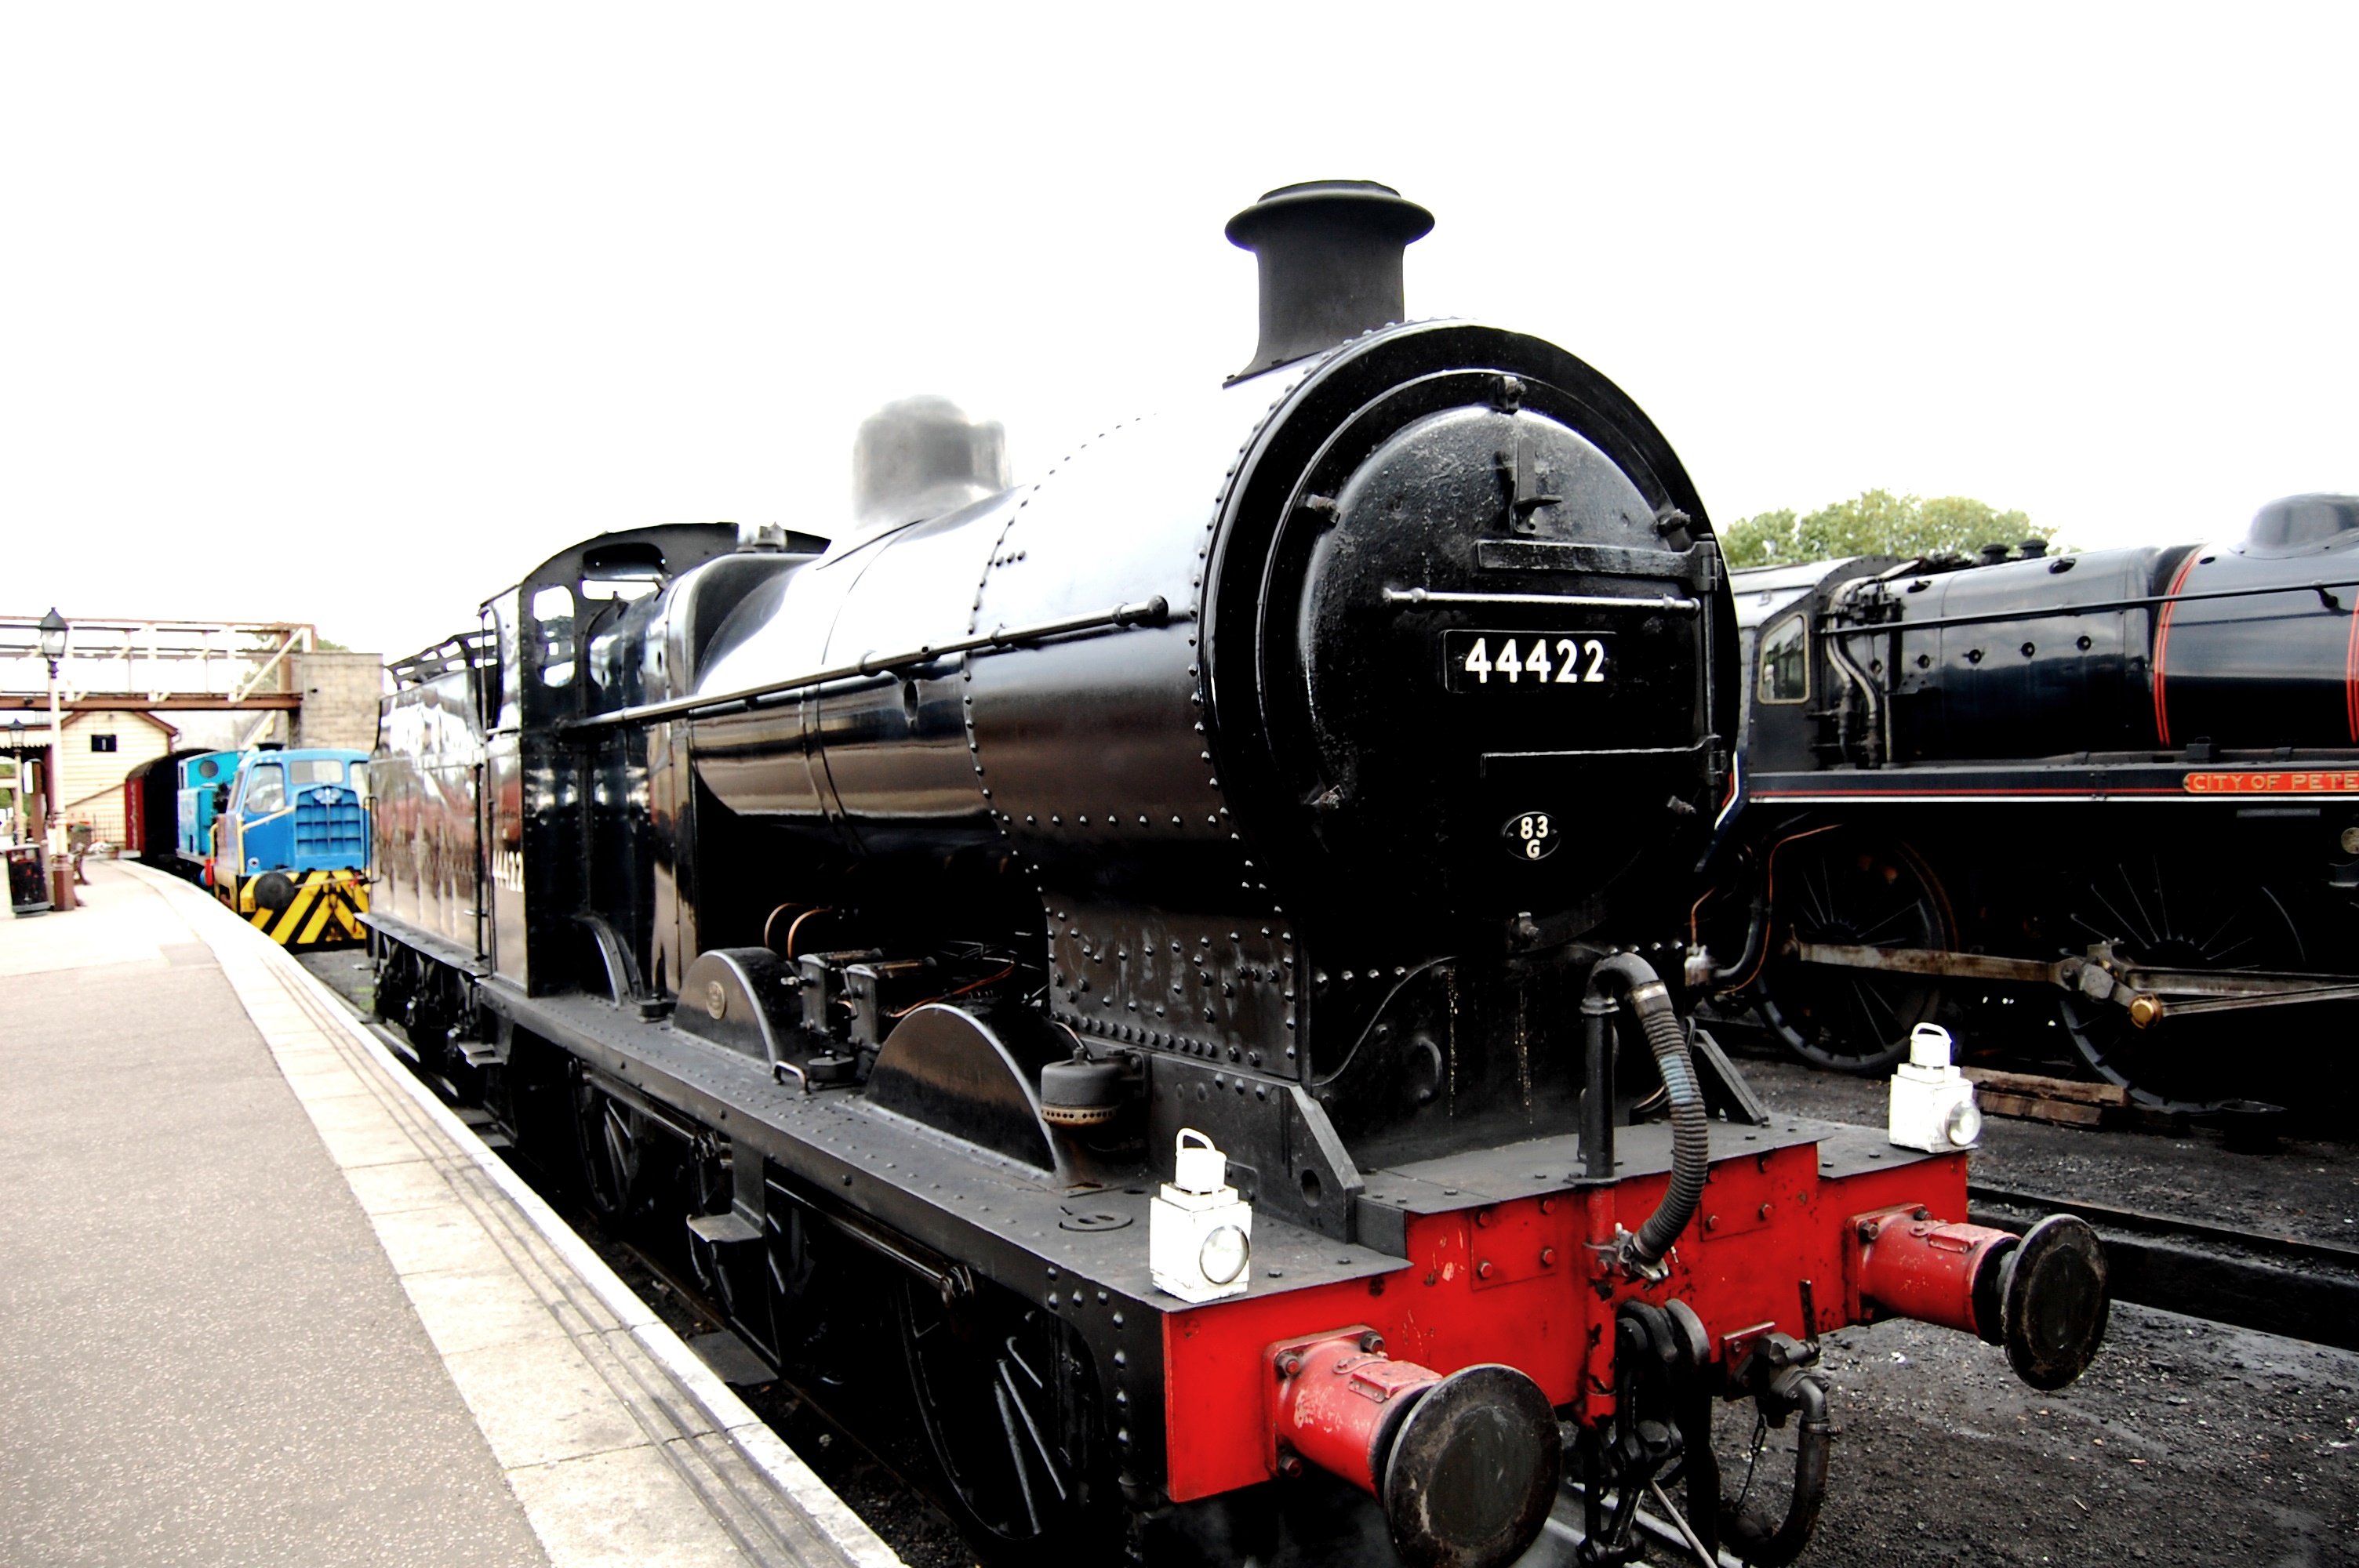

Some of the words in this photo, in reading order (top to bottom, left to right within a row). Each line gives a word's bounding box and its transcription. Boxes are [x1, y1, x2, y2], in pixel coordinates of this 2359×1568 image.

[1464, 637, 1605, 684] 44422
[2193, 775, 2243, 791] CITY
[2251, 775, 2281, 790] OF
[2292, 773, 2359, 790] PETE
[1520, 815, 1549, 840] 83
[1526, 838, 1541, 859] G
